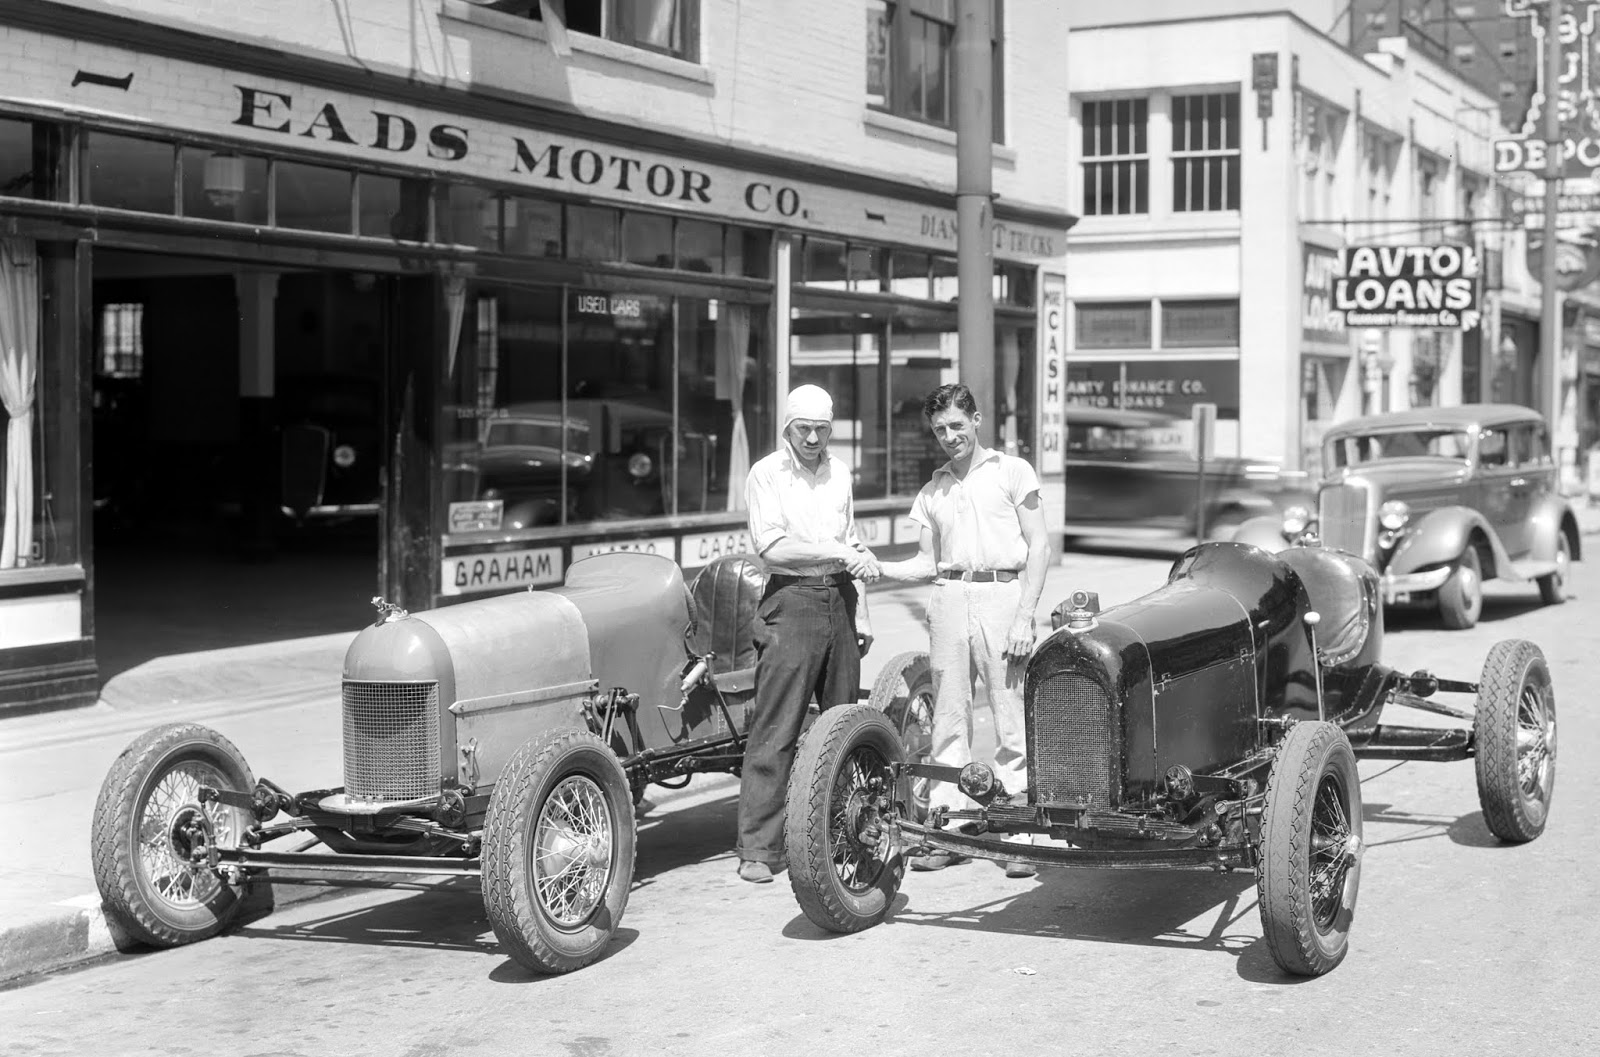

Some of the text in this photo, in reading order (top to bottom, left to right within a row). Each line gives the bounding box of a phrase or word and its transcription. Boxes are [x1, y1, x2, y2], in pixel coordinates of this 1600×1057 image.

[233, 85, 808, 221] EADS MOTOR CO.
[578, 295, 640, 317] USED CARS
[1336, 278, 1472, 310] LOANS
[1047, 311, 1060, 403] CASH
[1112, 380, 1175, 394] FNANCE
[699, 534, 748, 559] CARS
[455, 553, 552, 587] GRAHAM
